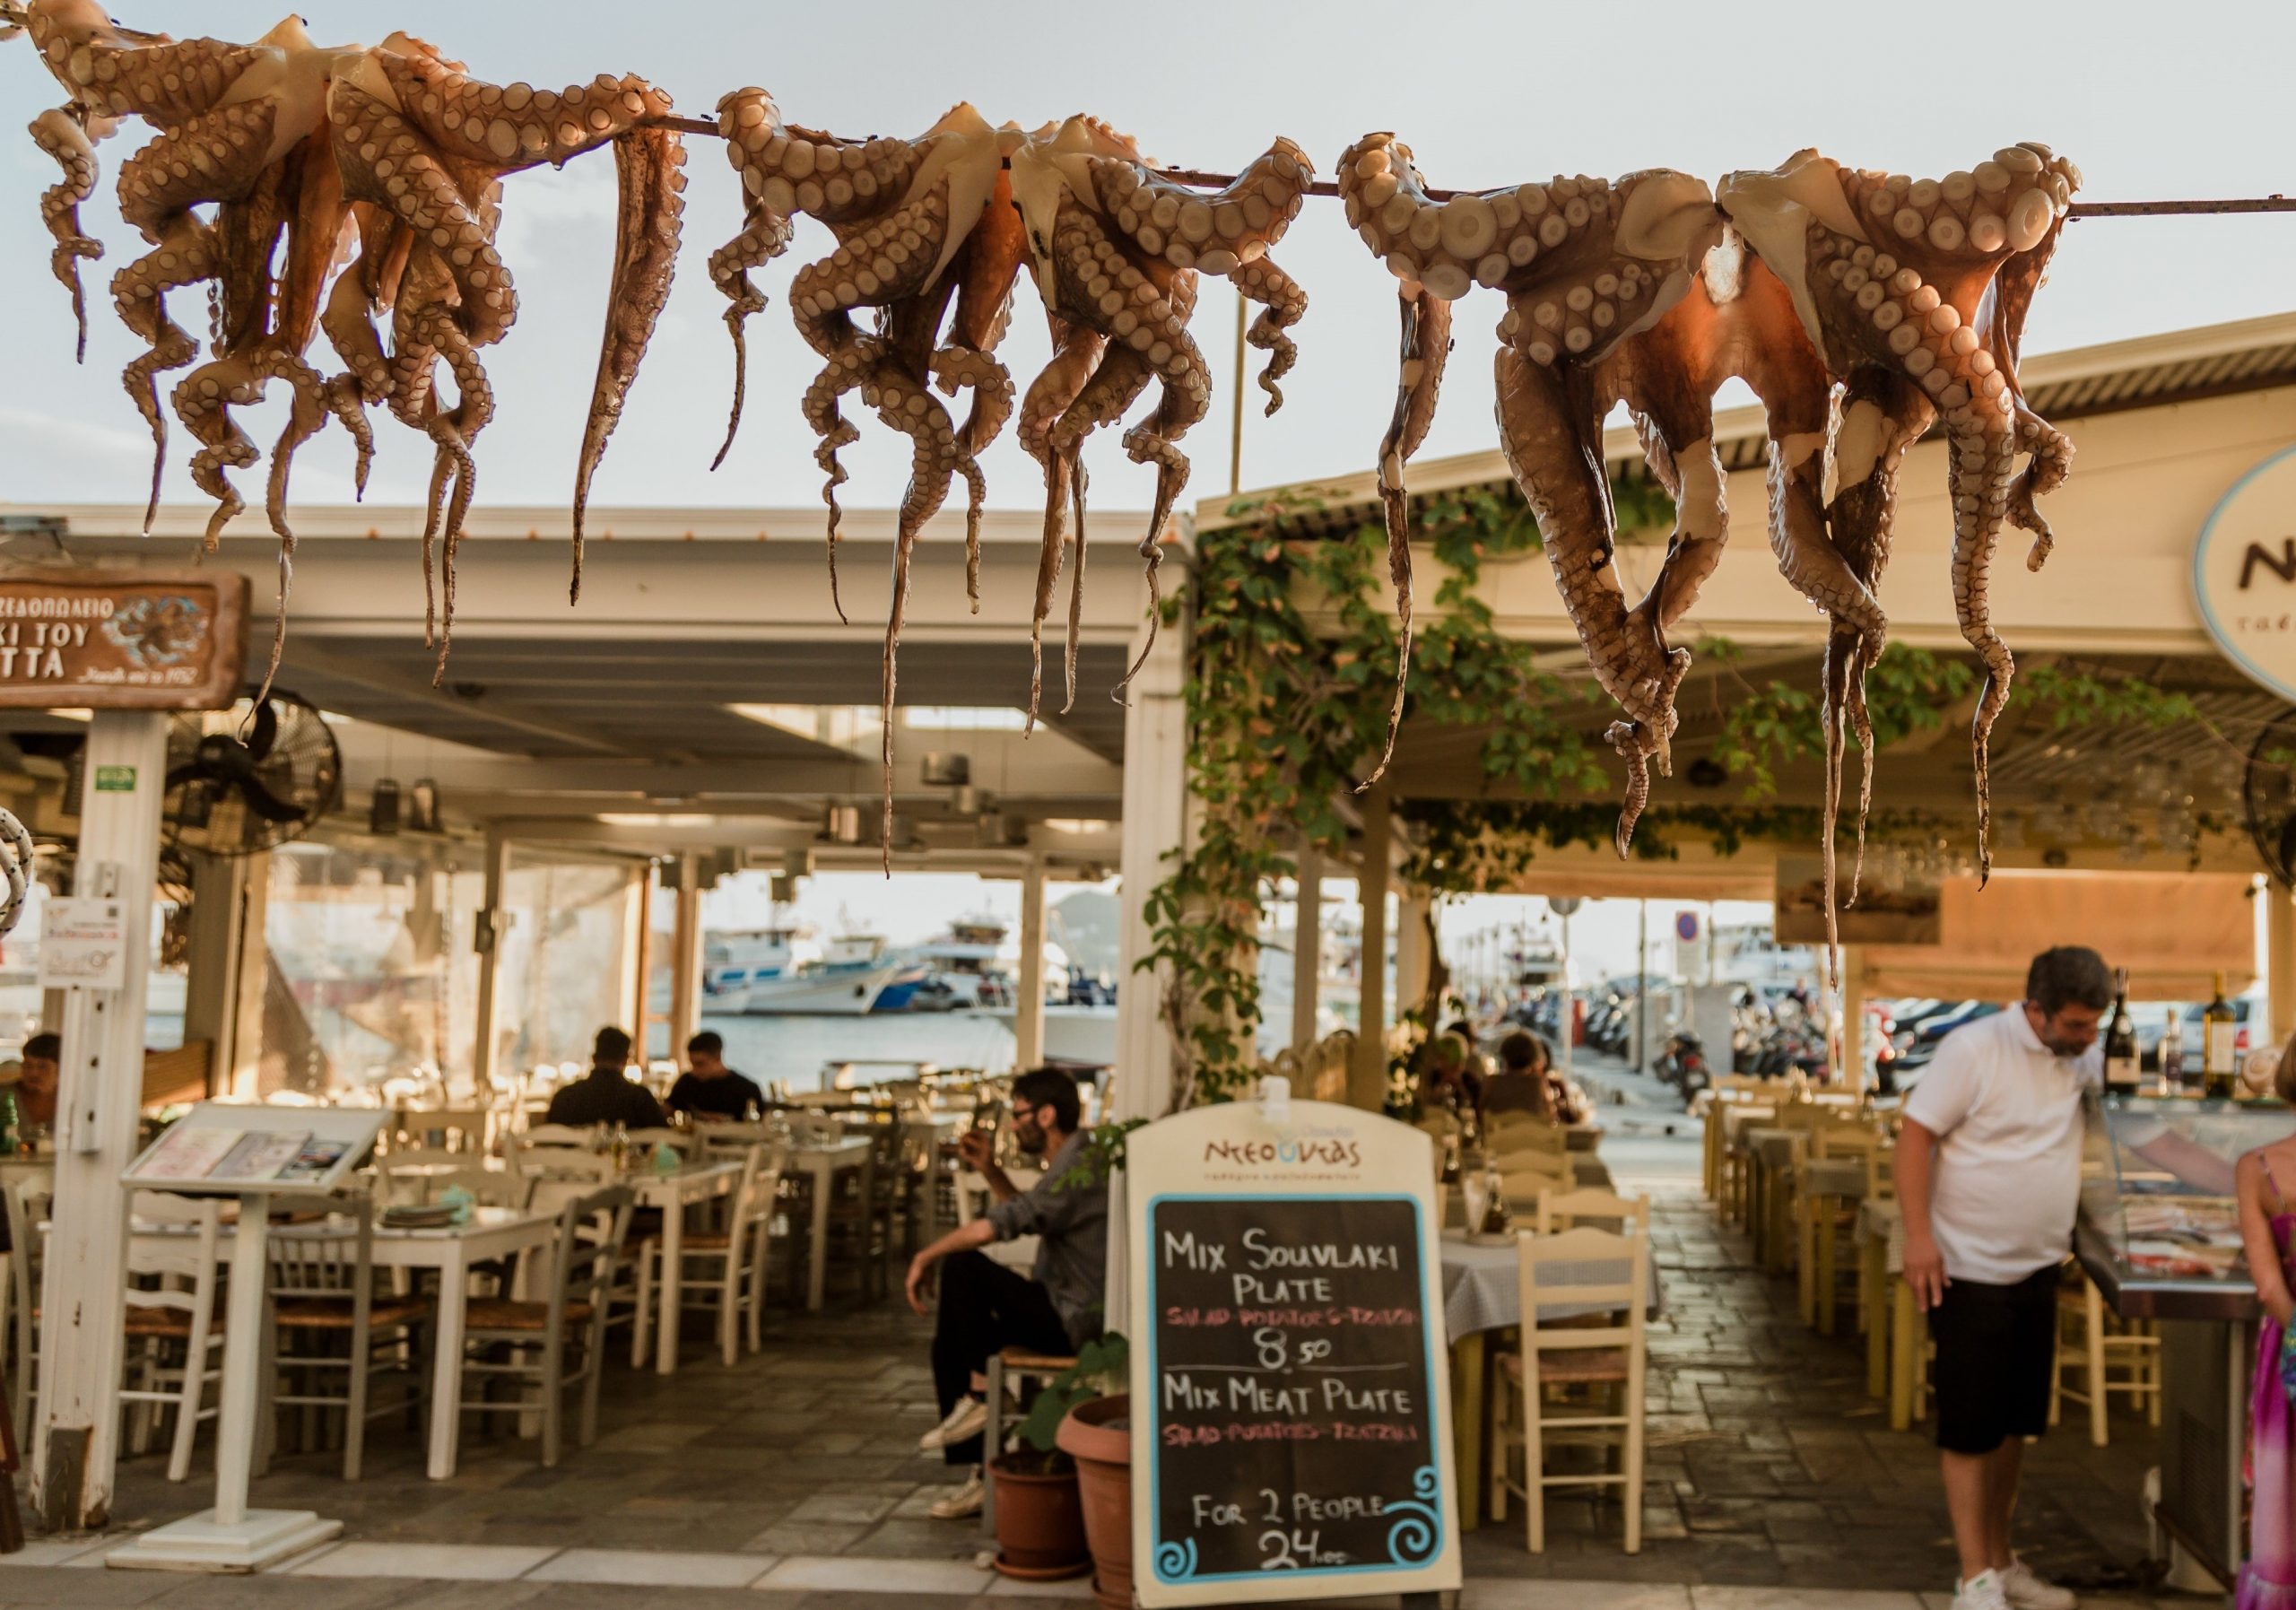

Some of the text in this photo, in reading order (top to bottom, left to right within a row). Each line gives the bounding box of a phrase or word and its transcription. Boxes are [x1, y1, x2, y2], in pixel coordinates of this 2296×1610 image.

[36, 622, 89, 647] ΤΟΥ
[1164, 1228, 1398, 1272] MIX SOUVLAKI
[1232, 1273, 1333, 1305] PLATE
[1163, 1372, 1413, 1414] MIX MEAT PLATE
[1192, 1488, 1384, 1527] FOR 2 PEOPLE
